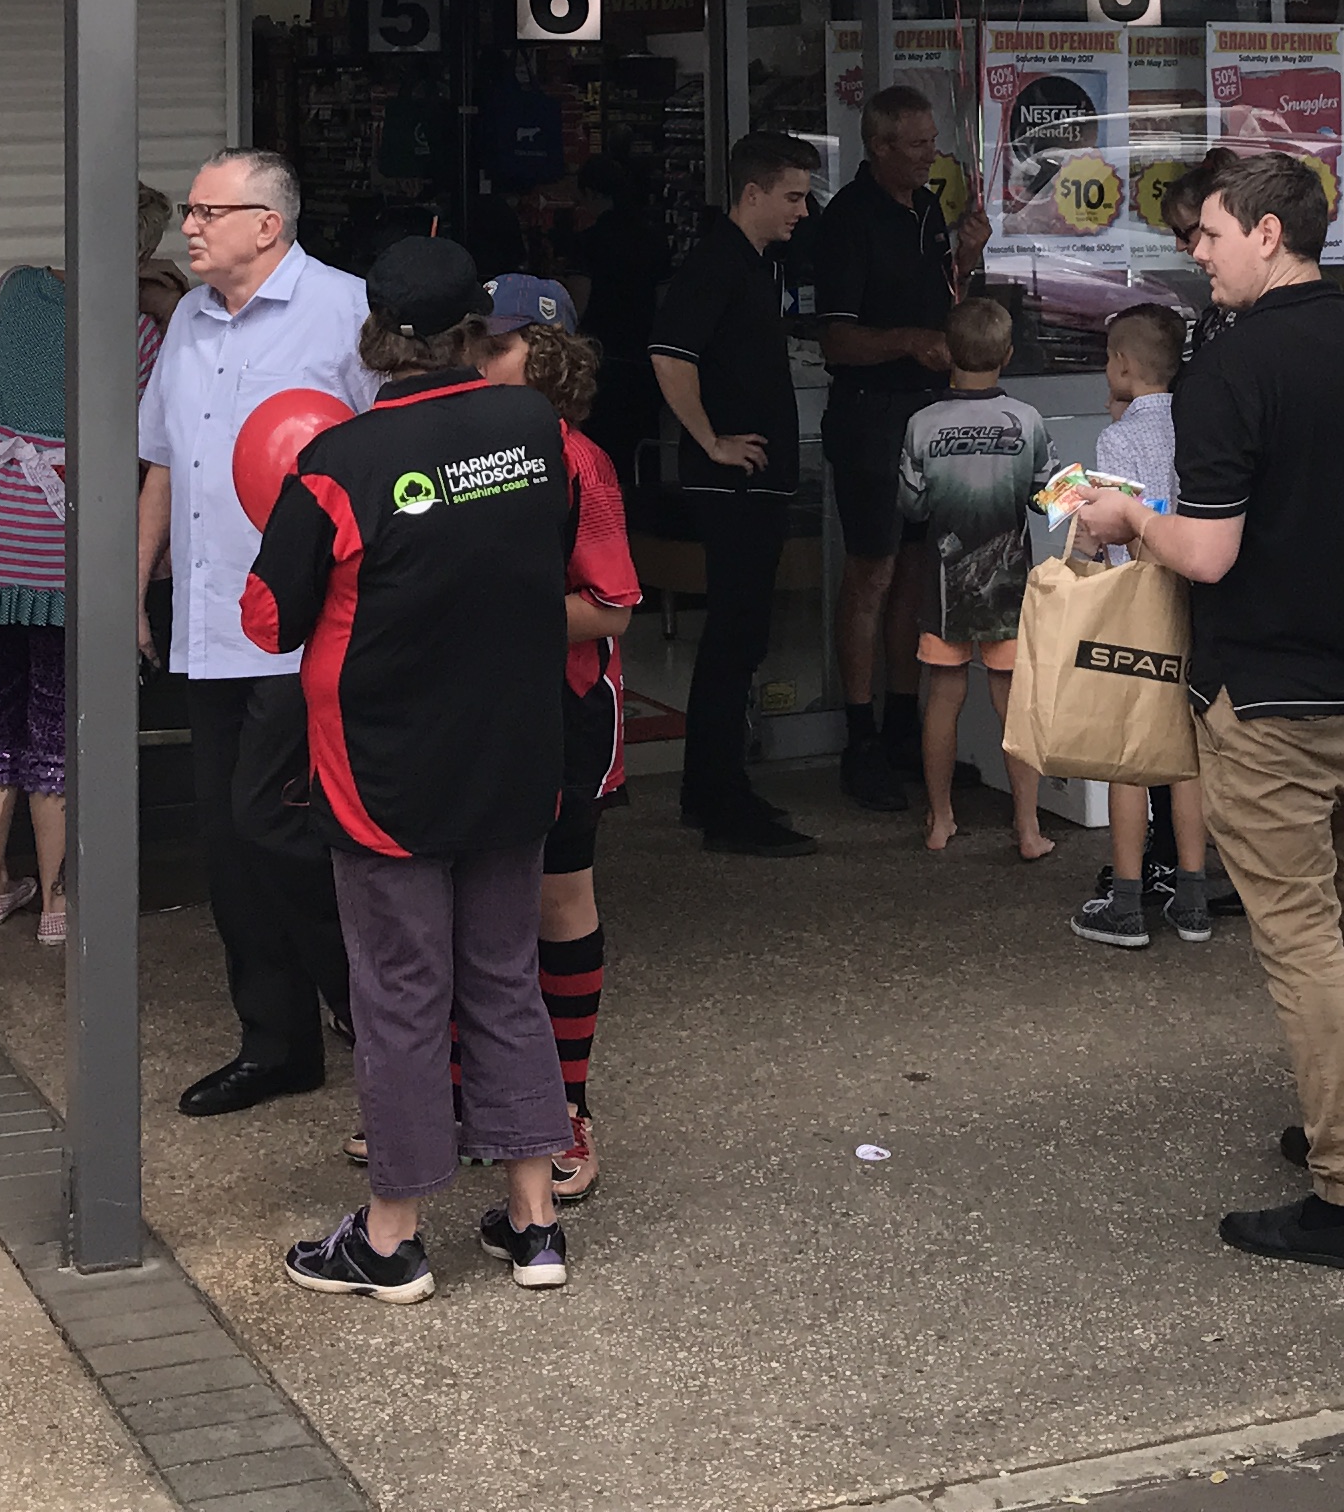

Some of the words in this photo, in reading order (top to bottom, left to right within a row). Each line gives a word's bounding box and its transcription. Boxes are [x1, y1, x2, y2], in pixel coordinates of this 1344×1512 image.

[994, 31, 1045, 51] GRAND
[1048, 31, 1115, 51] OPENING
[1218, 31, 1268, 51] GRAND
[1270, 32, 1334, 52] OPENING
[1061, 55, 1076, 65] May
[1077, 55, 1094, 63] 2017
[1282, 55, 1297, 65] May
[1298, 55, 1314, 63] 2017
[990, 67, 1014, 85] 60%
[1213, 69, 1238, 86] 50%
[993, 83, 1014, 97] OFF
[1217, 85, 1237, 97] OFF
[1276, 92, 1340, 115] Snugglers
[1059, 178, 1105, 210] $10
[938, 425, 1005, 439] TACKLE
[929, 438, 1026, 458] WORLD
[444, 445, 526, 479] HARMONY
[448, 457, 546, 493] LANDSCAPES
[452, 485, 502, 504] sunshine
[502, 477, 530, 492] coast
[1090, 647, 1179, 679] SPAR
